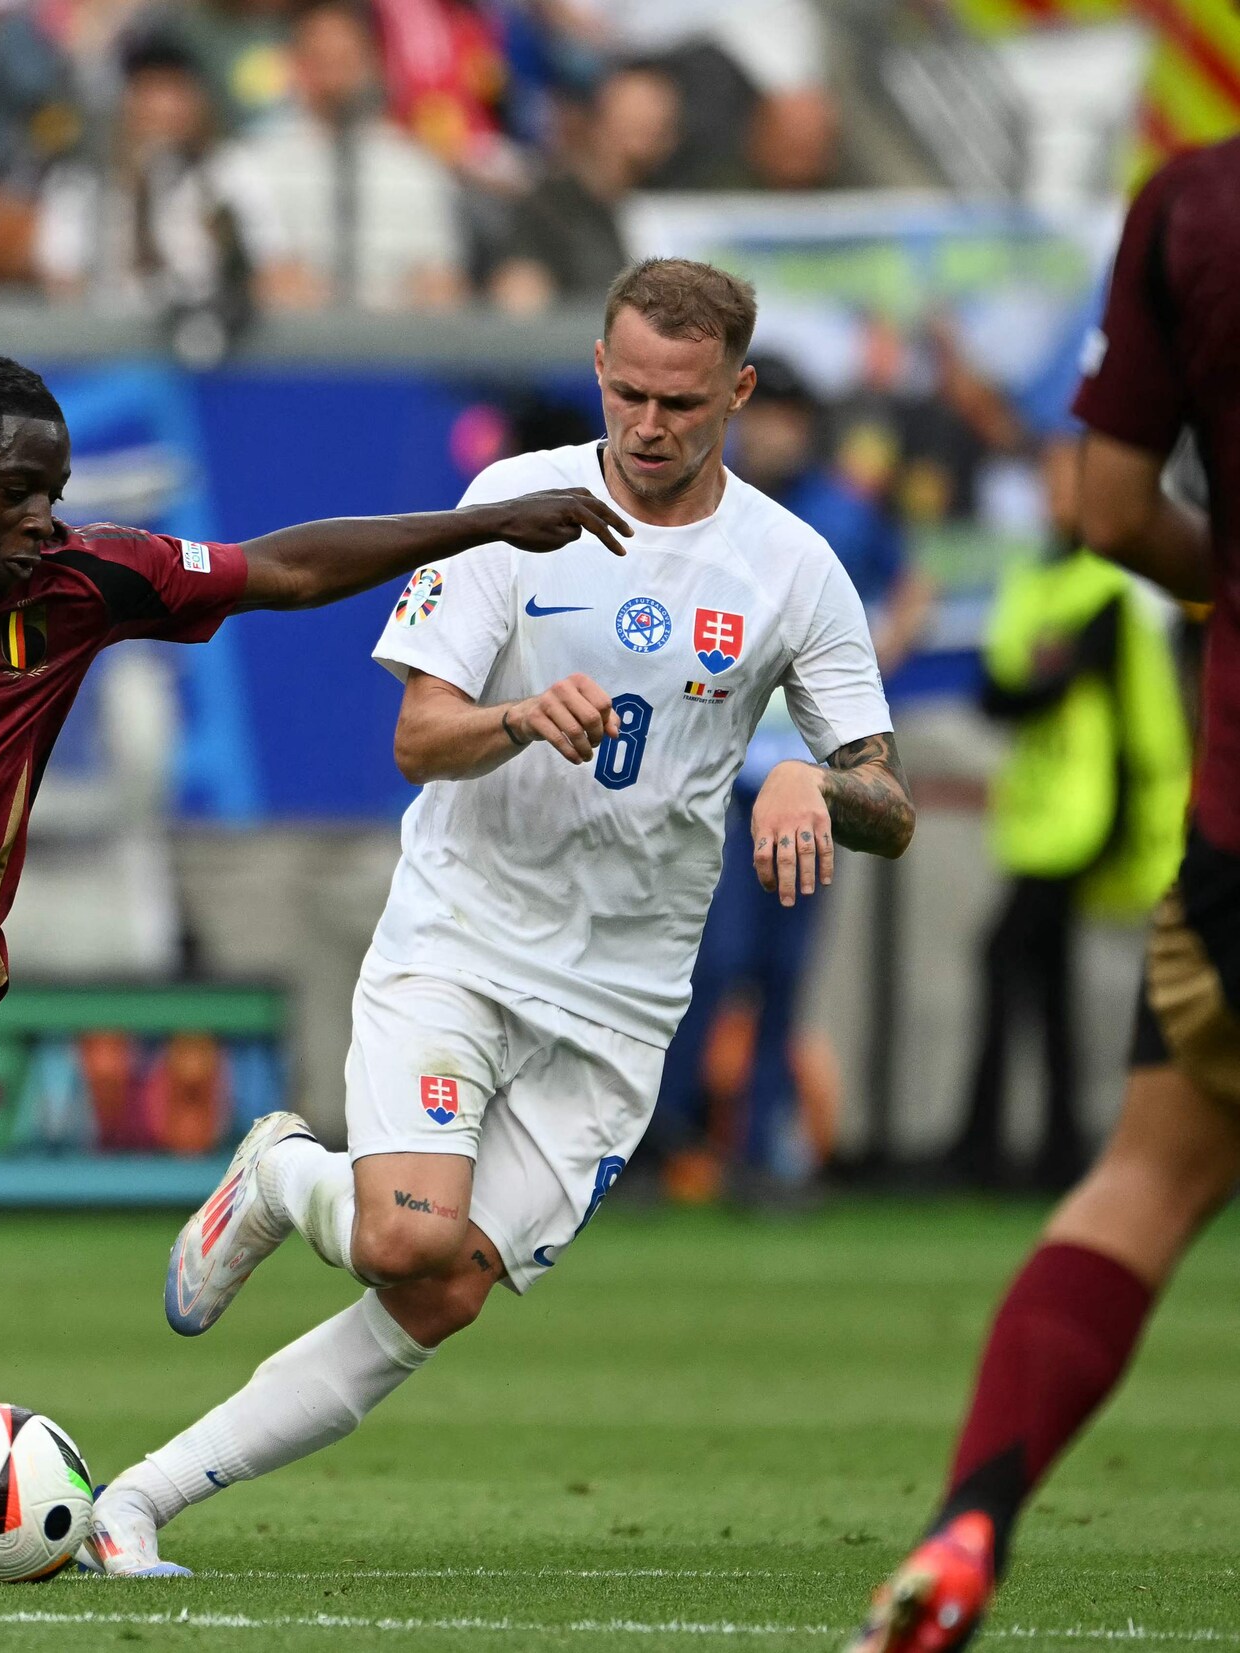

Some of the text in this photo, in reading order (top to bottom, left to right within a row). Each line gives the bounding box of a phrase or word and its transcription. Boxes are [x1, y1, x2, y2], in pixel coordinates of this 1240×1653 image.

[632, 645, 650, 653] SFZ
[594, 693, 654, 790] 8
[393, 1189, 431, 1214] Work
[574, 1155, 627, 1240] 8
